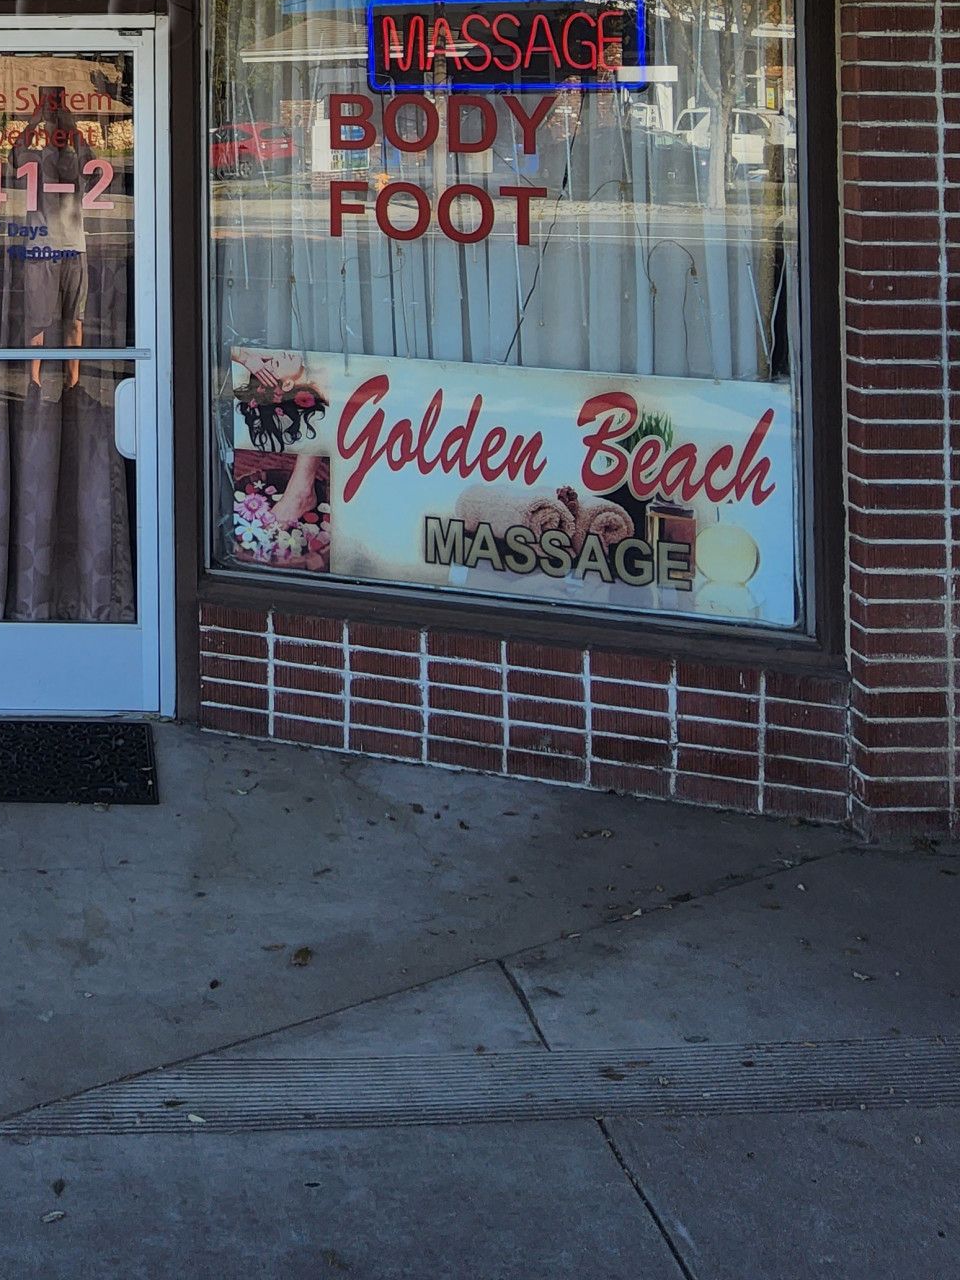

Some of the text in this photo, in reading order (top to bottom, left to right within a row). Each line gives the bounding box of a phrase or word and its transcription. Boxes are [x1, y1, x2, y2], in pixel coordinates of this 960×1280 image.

[381, 11, 623, 72] MASSAGE
[15, 87, 112, 117] System
[329, 93, 556, 155] BODY
[7, 223, 49, 240] Days
[329, 181, 547, 246] FOOT
[337, 374, 776, 506] Golden Beach
[424, 516, 693, 592] MASSAGE
